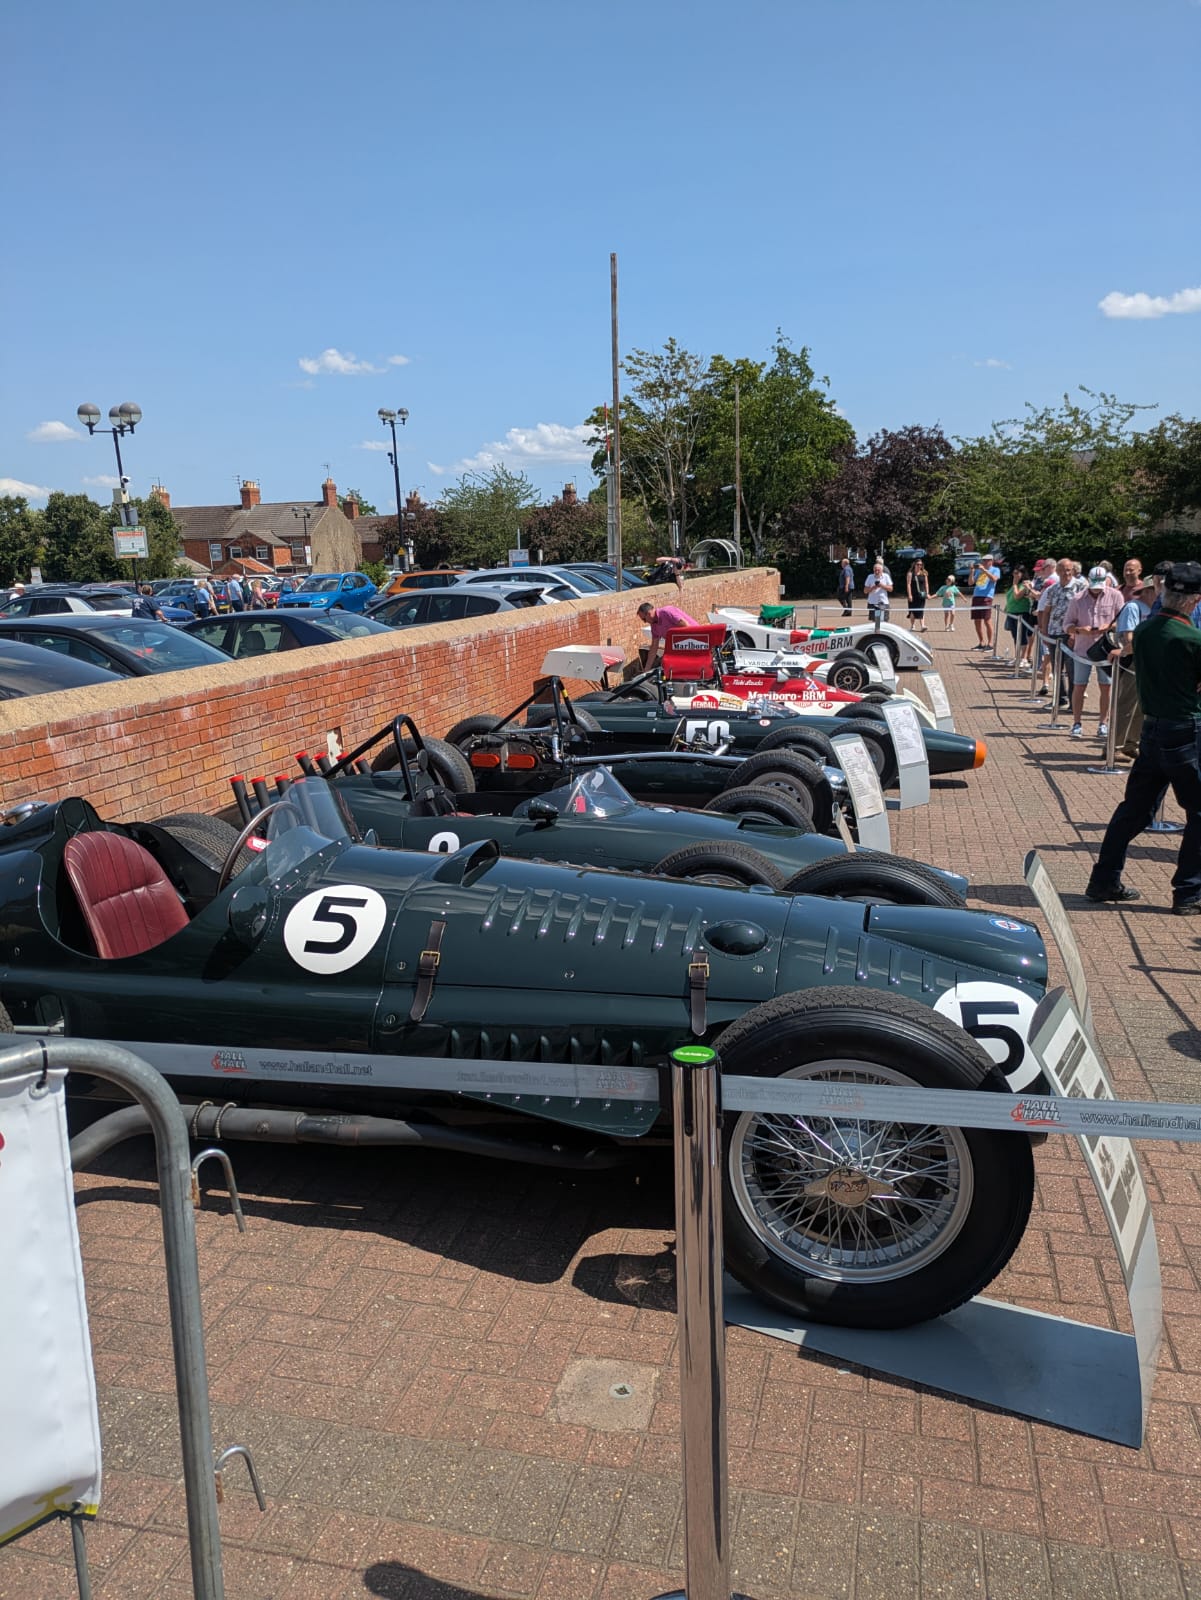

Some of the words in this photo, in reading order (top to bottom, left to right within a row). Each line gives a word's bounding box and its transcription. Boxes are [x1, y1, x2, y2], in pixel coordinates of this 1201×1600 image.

[673, 641, 709, 650] Marlboro
[692, 701, 716, 709] KENDALL
[303, 896, 369, 954] 5
[959, 1001, 1025, 1076] 5
[217, 1051, 243, 1060] HALL
[220, 1060, 247, 1069] HALL
[1021, 1100, 1057, 1111] HALL
[1023, 1110, 1061, 1121] HALL
